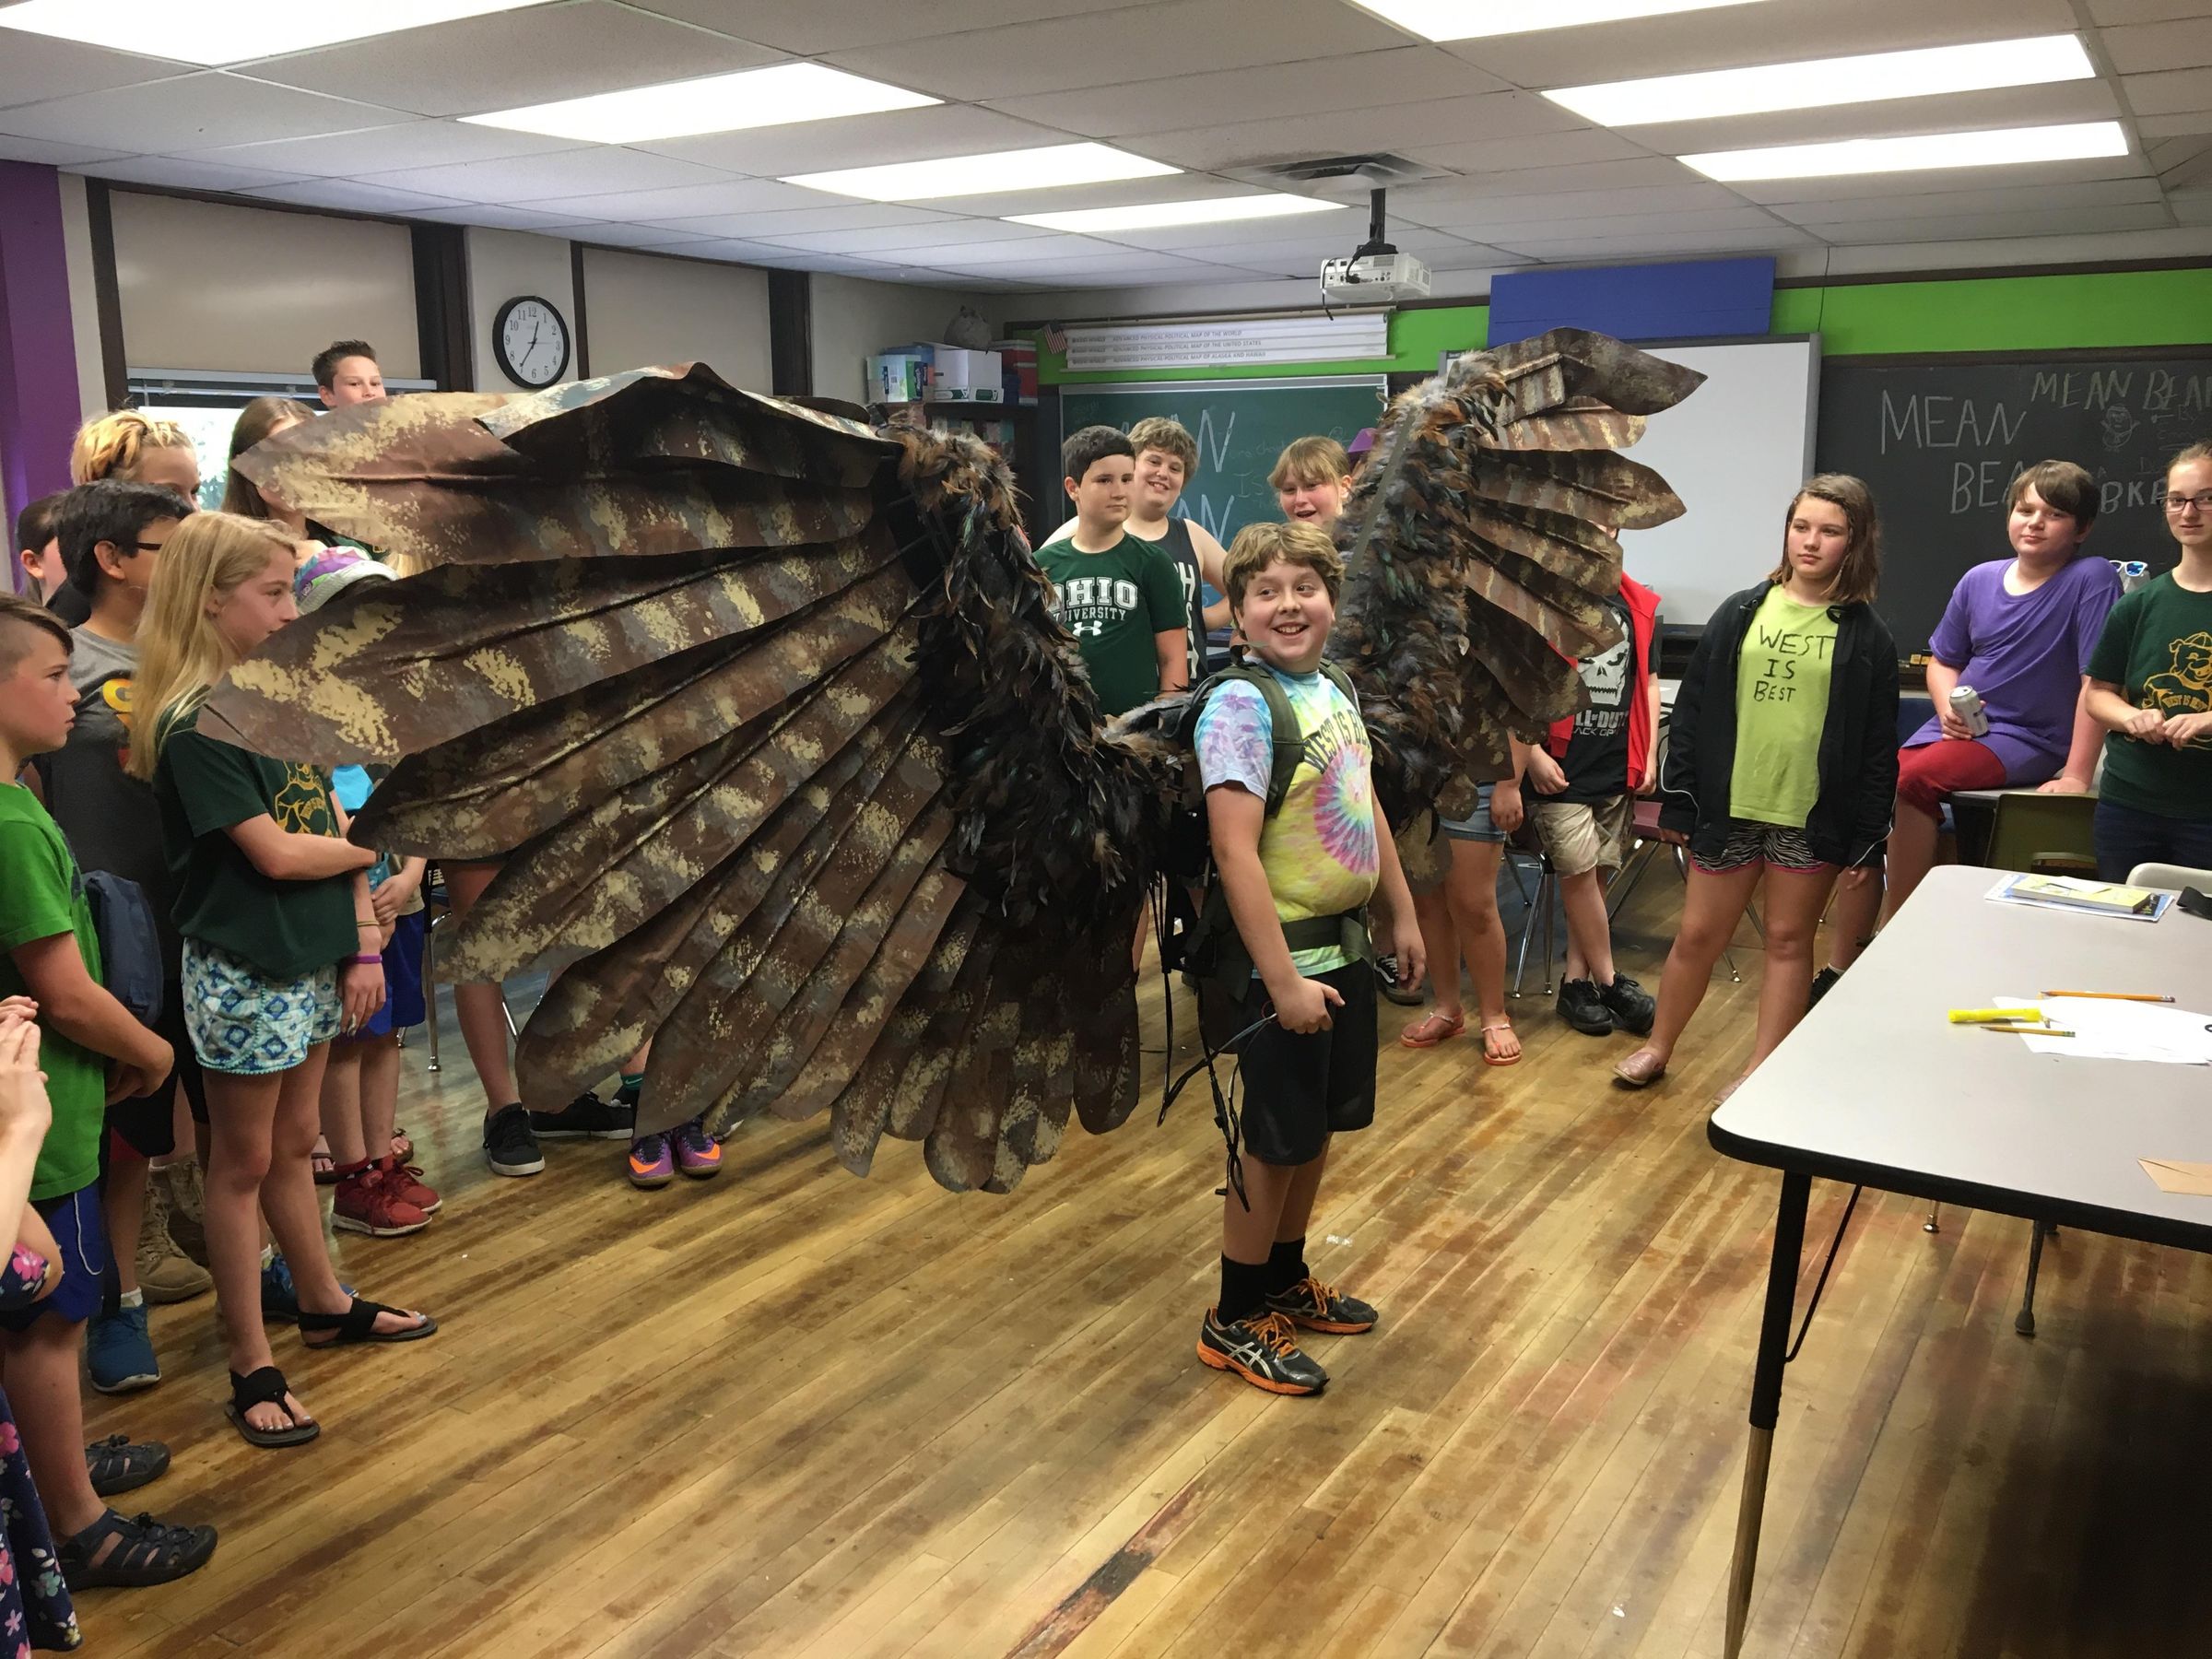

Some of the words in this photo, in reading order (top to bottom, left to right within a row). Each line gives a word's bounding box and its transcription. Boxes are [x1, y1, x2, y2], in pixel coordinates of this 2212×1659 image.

[517, 309, 526, 321] 11
[528, 306, 537, 318] 12
[543, 312, 547, 324] 1
[510, 319, 519, 331] 10
[551, 324, 558, 335] 2
[504, 334, 511, 346] 9
[555, 340, 561, 352] 3
[509, 350, 515, 361] 8
[531, 368, 537, 379] 6
[544, 365, 549, 376] 5
[2030, 370, 2134, 410] MEAN
[1880, 389, 2028, 455] MEAN
[1053, 606, 1126, 625] IVERSITY
[1759, 625, 1837, 660] WEST
[1763, 658, 1796, 679] IS
[1754, 680, 1797, 702] BEST
[1572, 726, 1598, 736] ACK
